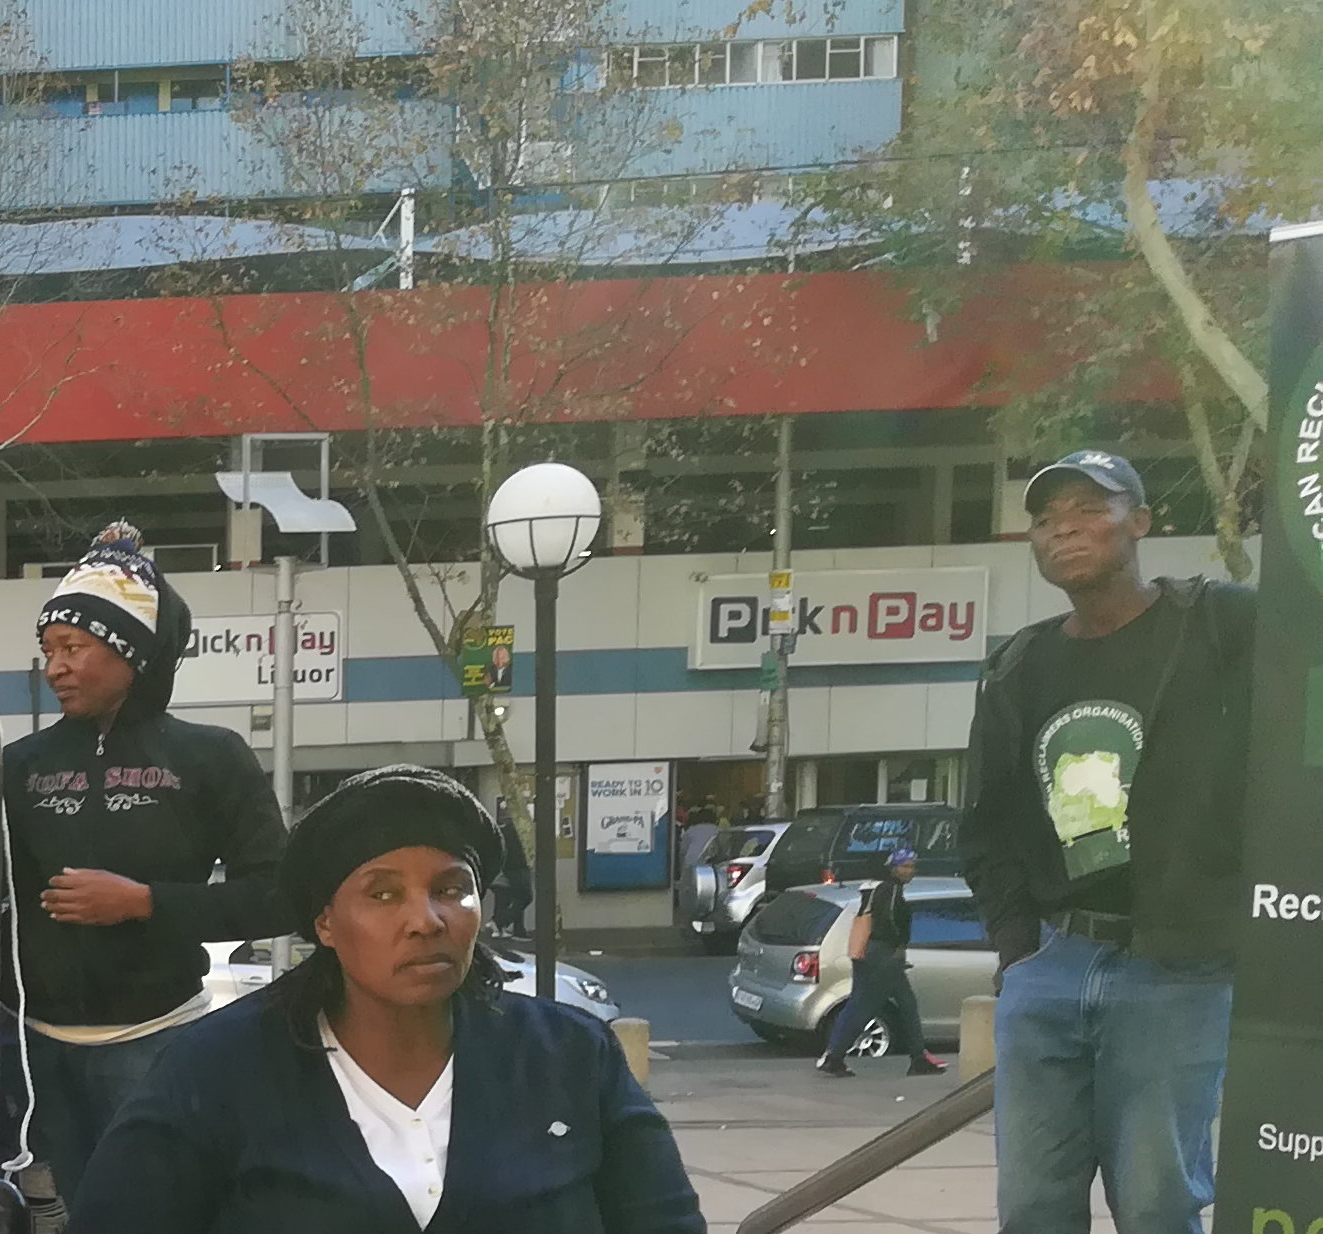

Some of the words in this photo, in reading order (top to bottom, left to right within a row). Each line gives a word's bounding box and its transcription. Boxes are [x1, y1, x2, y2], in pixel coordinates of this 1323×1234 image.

[831, 605, 857, 634] n
[867, 592, 975, 640] Pay
[246, 634, 262, 651] n
[269, 626, 335, 655] ay
[258, 666, 334, 684] Liuor
[591, 780, 623, 789] READY
[591, 789, 627, 797] WORK
